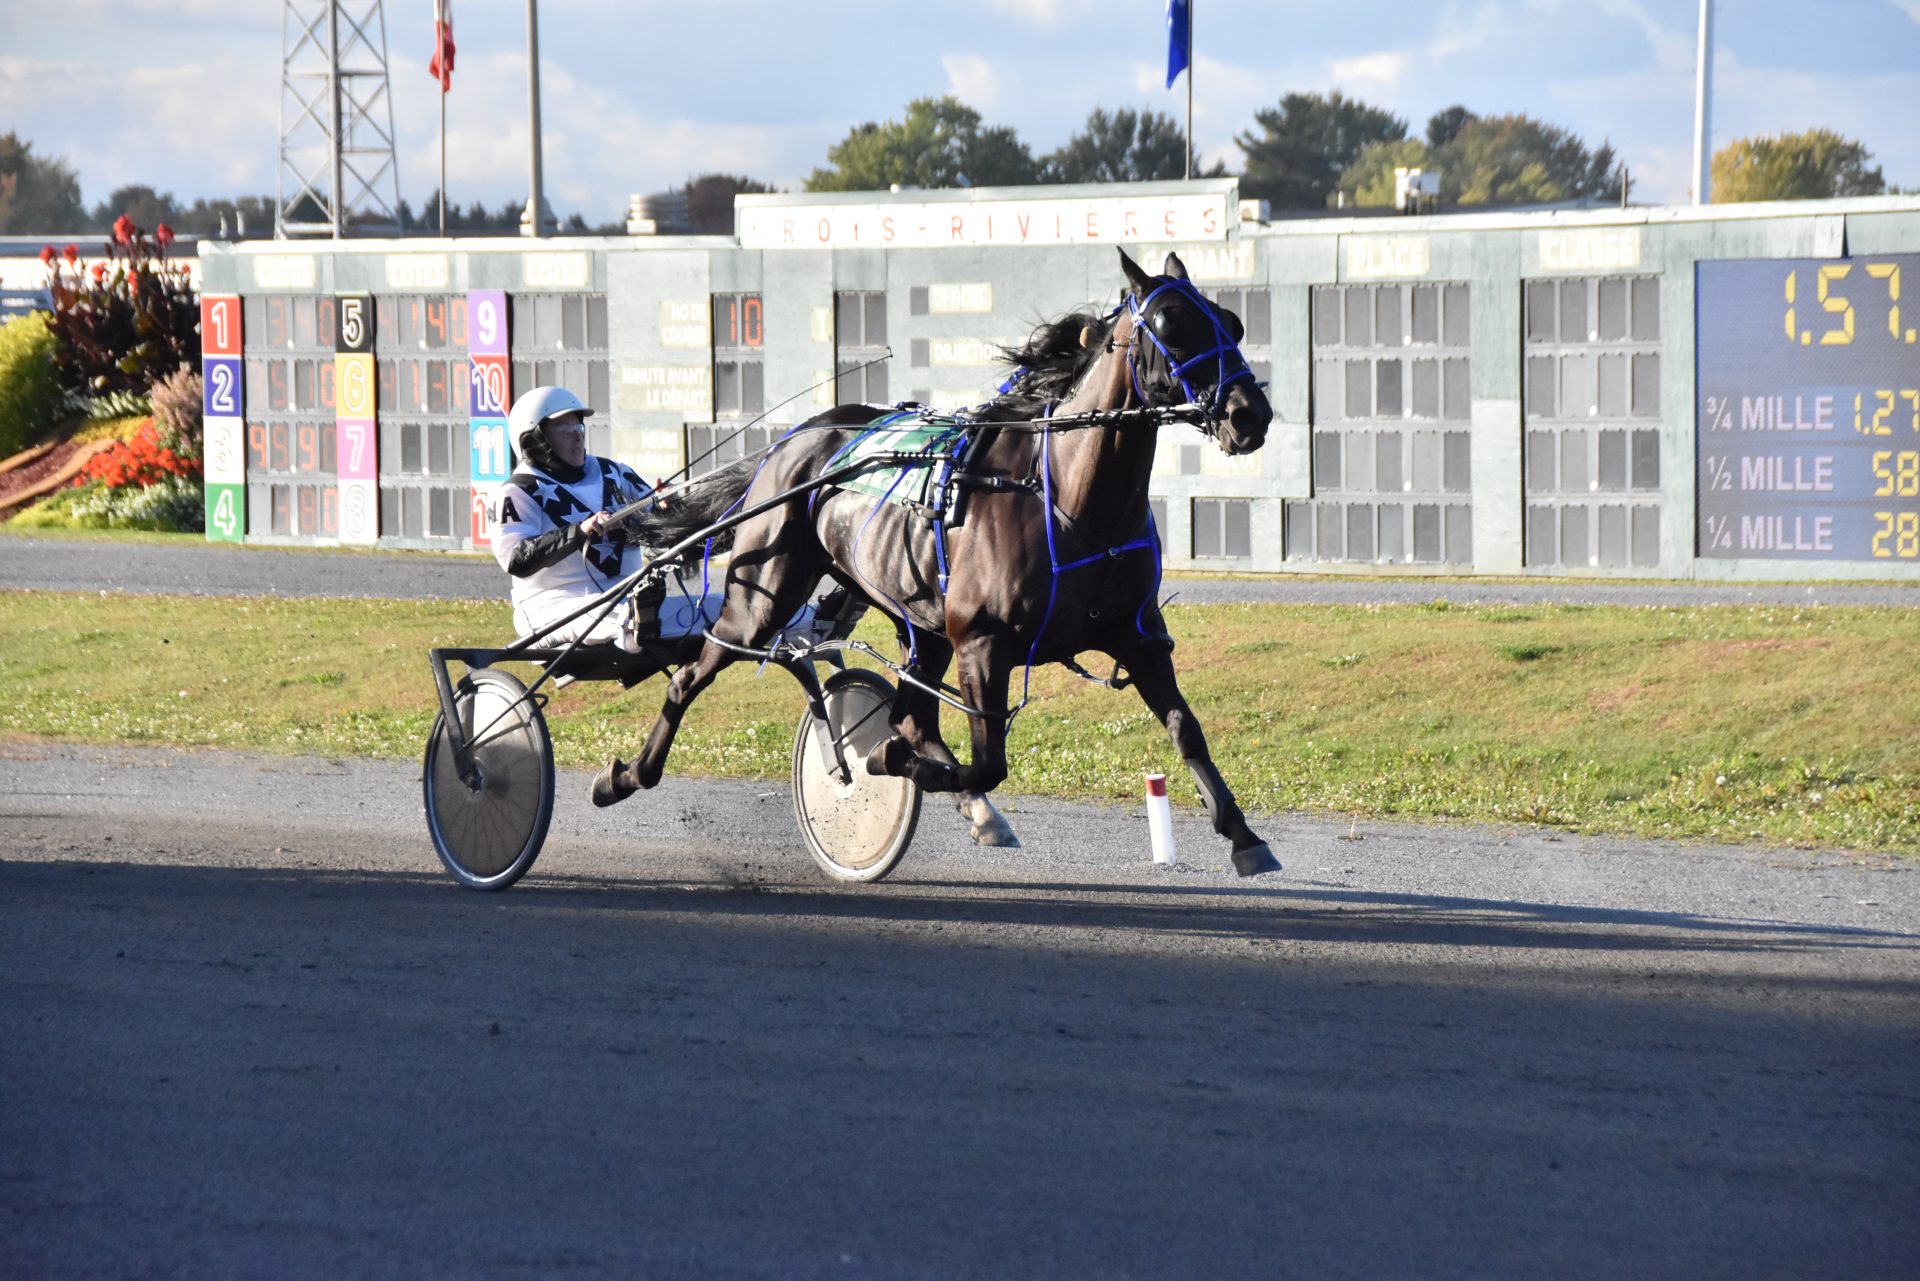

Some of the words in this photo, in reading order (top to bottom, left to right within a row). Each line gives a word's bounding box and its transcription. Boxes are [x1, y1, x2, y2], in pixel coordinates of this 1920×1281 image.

[211, 301, 228, 349] 1
[341, 299, 364, 349] 5
[477, 300, 498, 346] 9
[730, 298, 762, 346] 10
[212, 364, 234, 412] 2
[343, 361, 367, 412] 6
[471, 362, 506, 412] 10
[667, 368, 705, 384] AVANT
[1741, 396, 1834, 431] MILLE
[213, 427, 234, 473] 3
[345, 425, 366, 473] 7
[472, 422, 507, 476] 11
[1741, 456, 1834, 491] MILLE
[1873, 451, 1919, 497] 58
[213, 489, 236, 536] 4
[345, 484, 368, 539] 8
[1741, 515, 1834, 550] MILLE
[1873, 512, 1919, 558] 28
